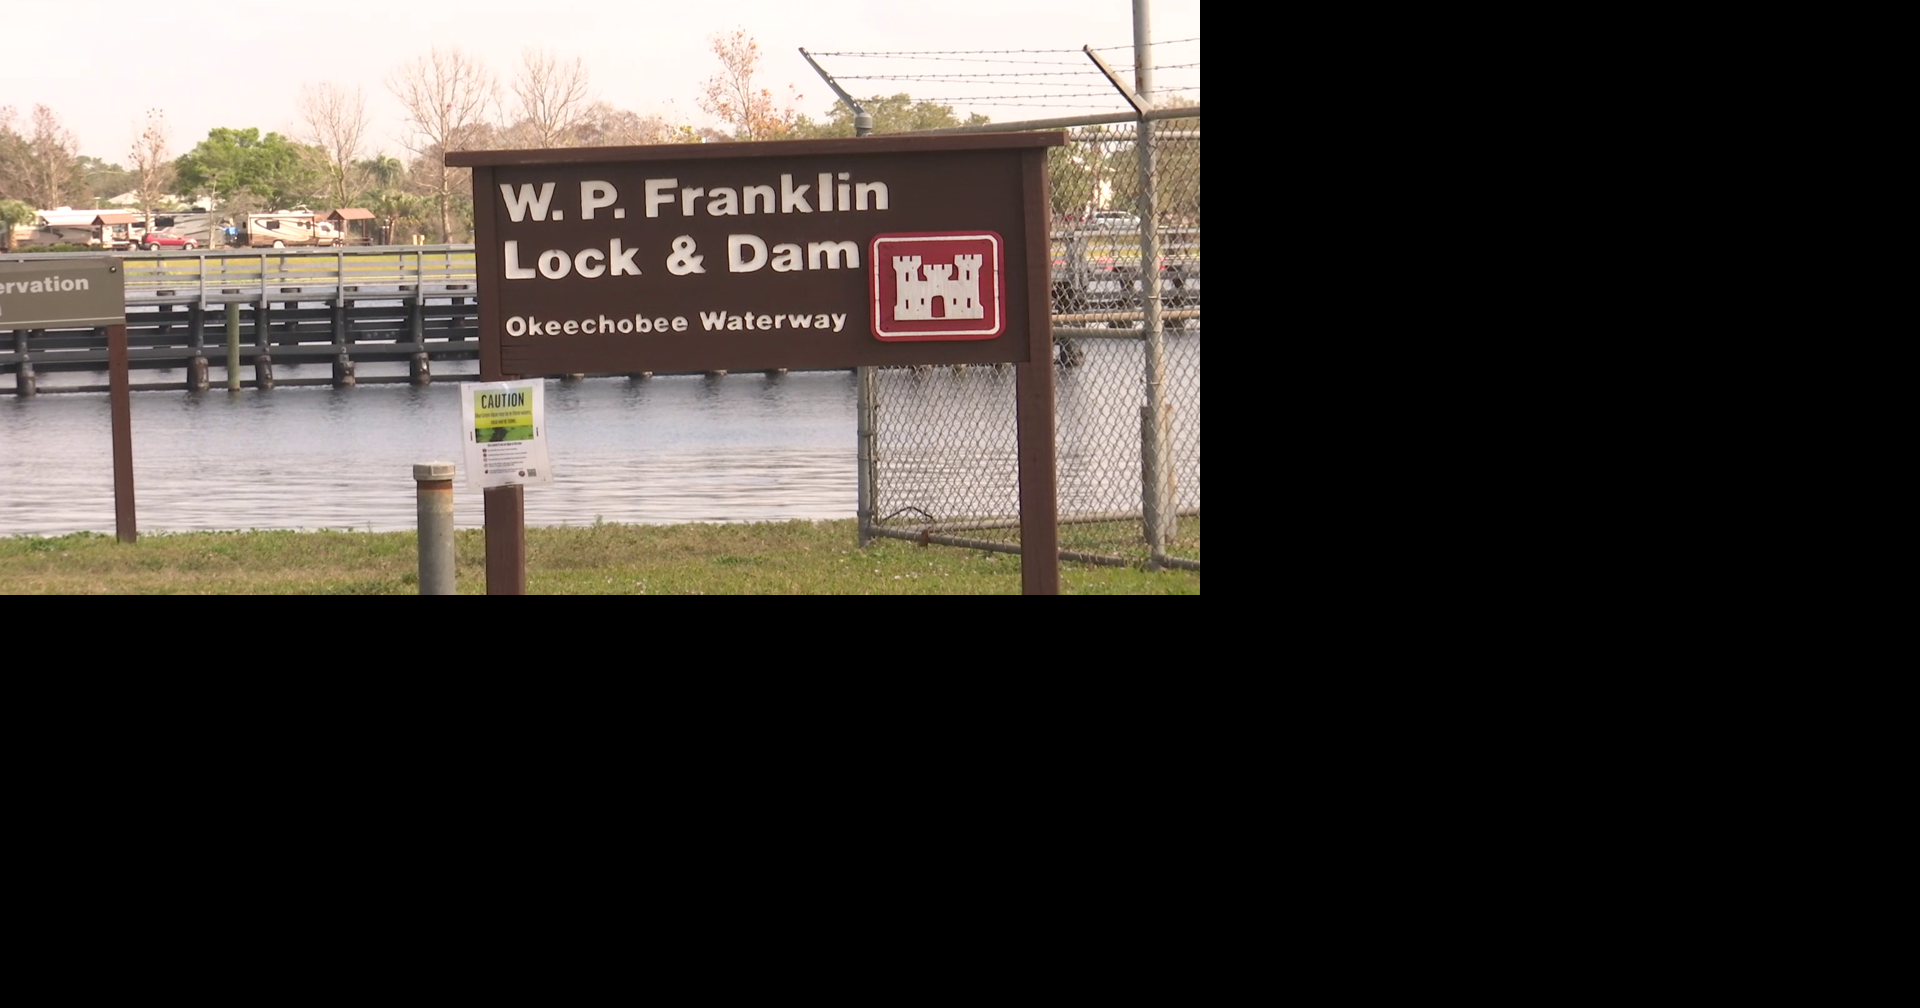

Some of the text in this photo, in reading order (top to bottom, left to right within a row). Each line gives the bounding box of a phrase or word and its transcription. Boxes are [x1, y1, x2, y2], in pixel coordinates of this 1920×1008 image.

[500, 172, 889, 222] W. P. Franklin
[504, 234, 860, 280] Lock & Dam
[505, 311, 847, 337] Okeechobee Waterway
[481, 392, 525, 409] CAUTION
